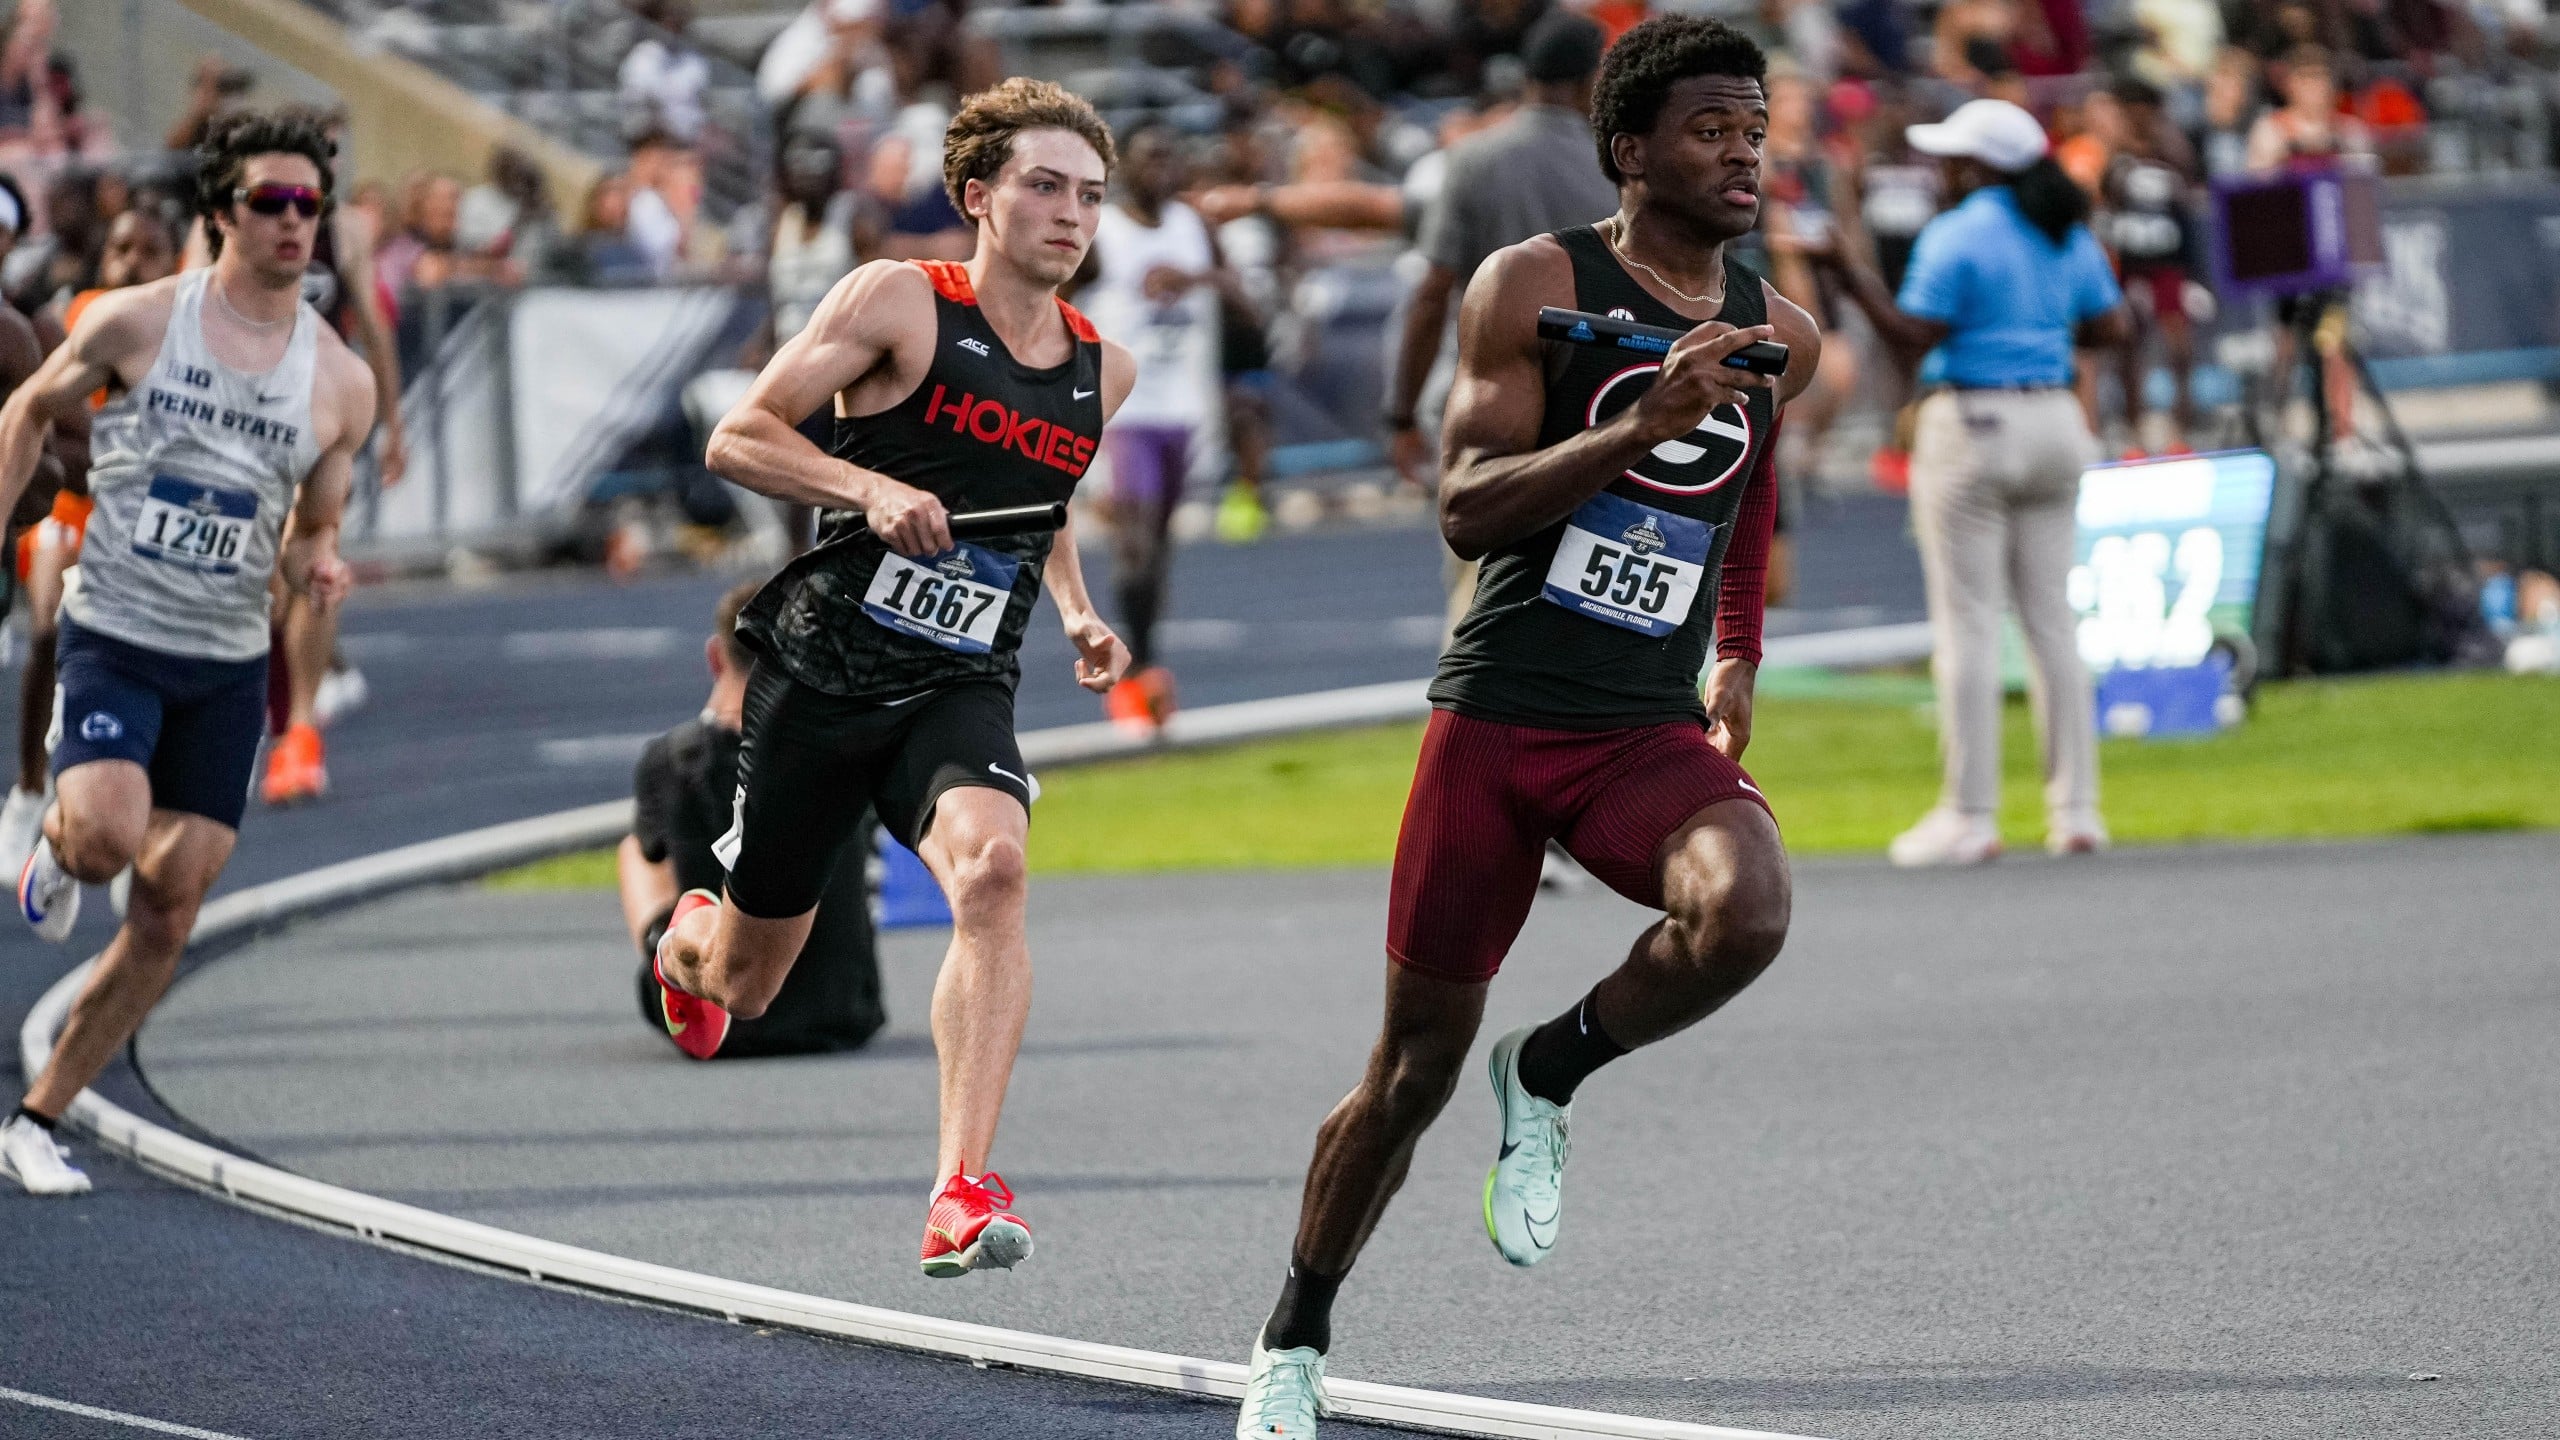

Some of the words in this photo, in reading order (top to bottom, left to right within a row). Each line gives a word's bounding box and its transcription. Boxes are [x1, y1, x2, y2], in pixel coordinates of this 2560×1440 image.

[957, 338, 990, 356] ACC
[148, 390, 216, 422] PENN
[221, 409, 299, 446] STATE
[924, 384, 1095, 477] HOKIES
[148, 508, 241, 558] 1296
[882, 567, 996, 634] 1667
[1579, 543, 1678, 614] 555
[1626, 614, 1653, 628] FLORIDA
